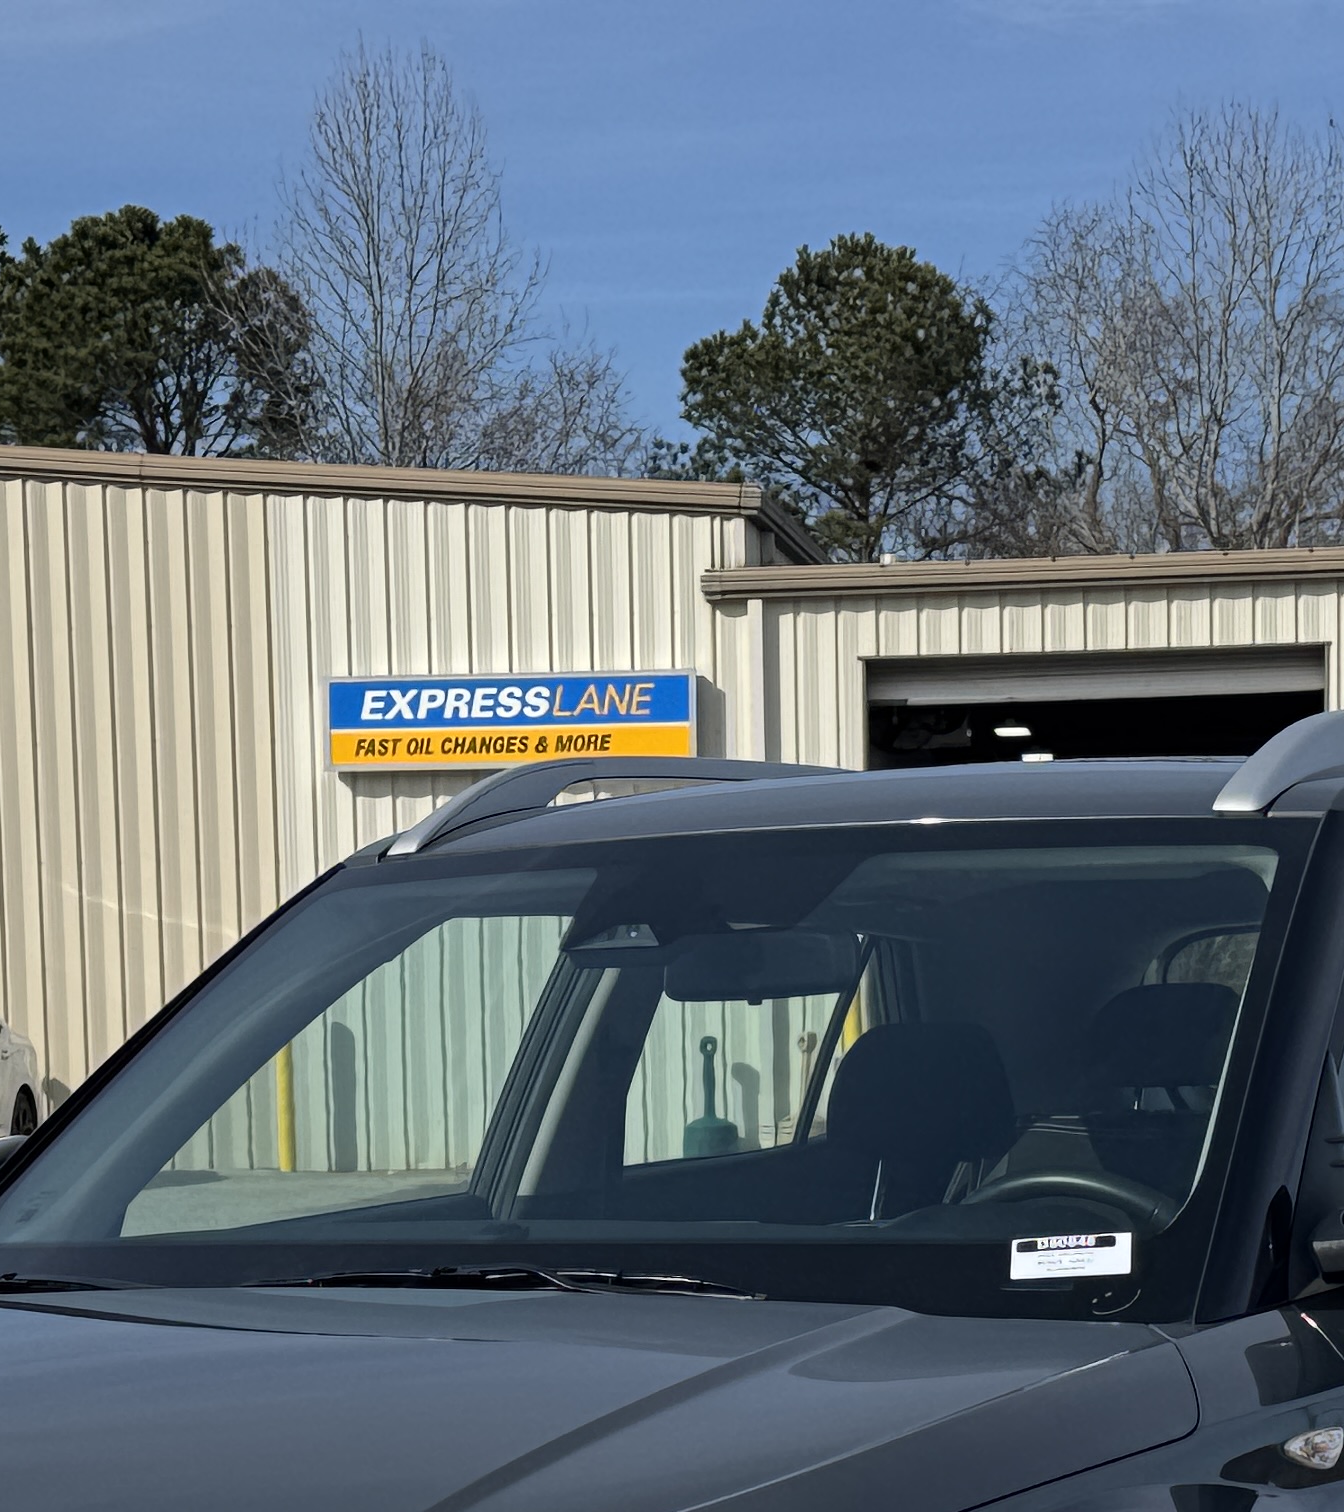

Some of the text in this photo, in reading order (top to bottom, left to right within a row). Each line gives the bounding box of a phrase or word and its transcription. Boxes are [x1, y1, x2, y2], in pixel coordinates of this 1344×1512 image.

[360, 682, 655, 720] EXPRESSLANE
[354, 733, 612, 757] FAST OIL CHANGES & MORE
